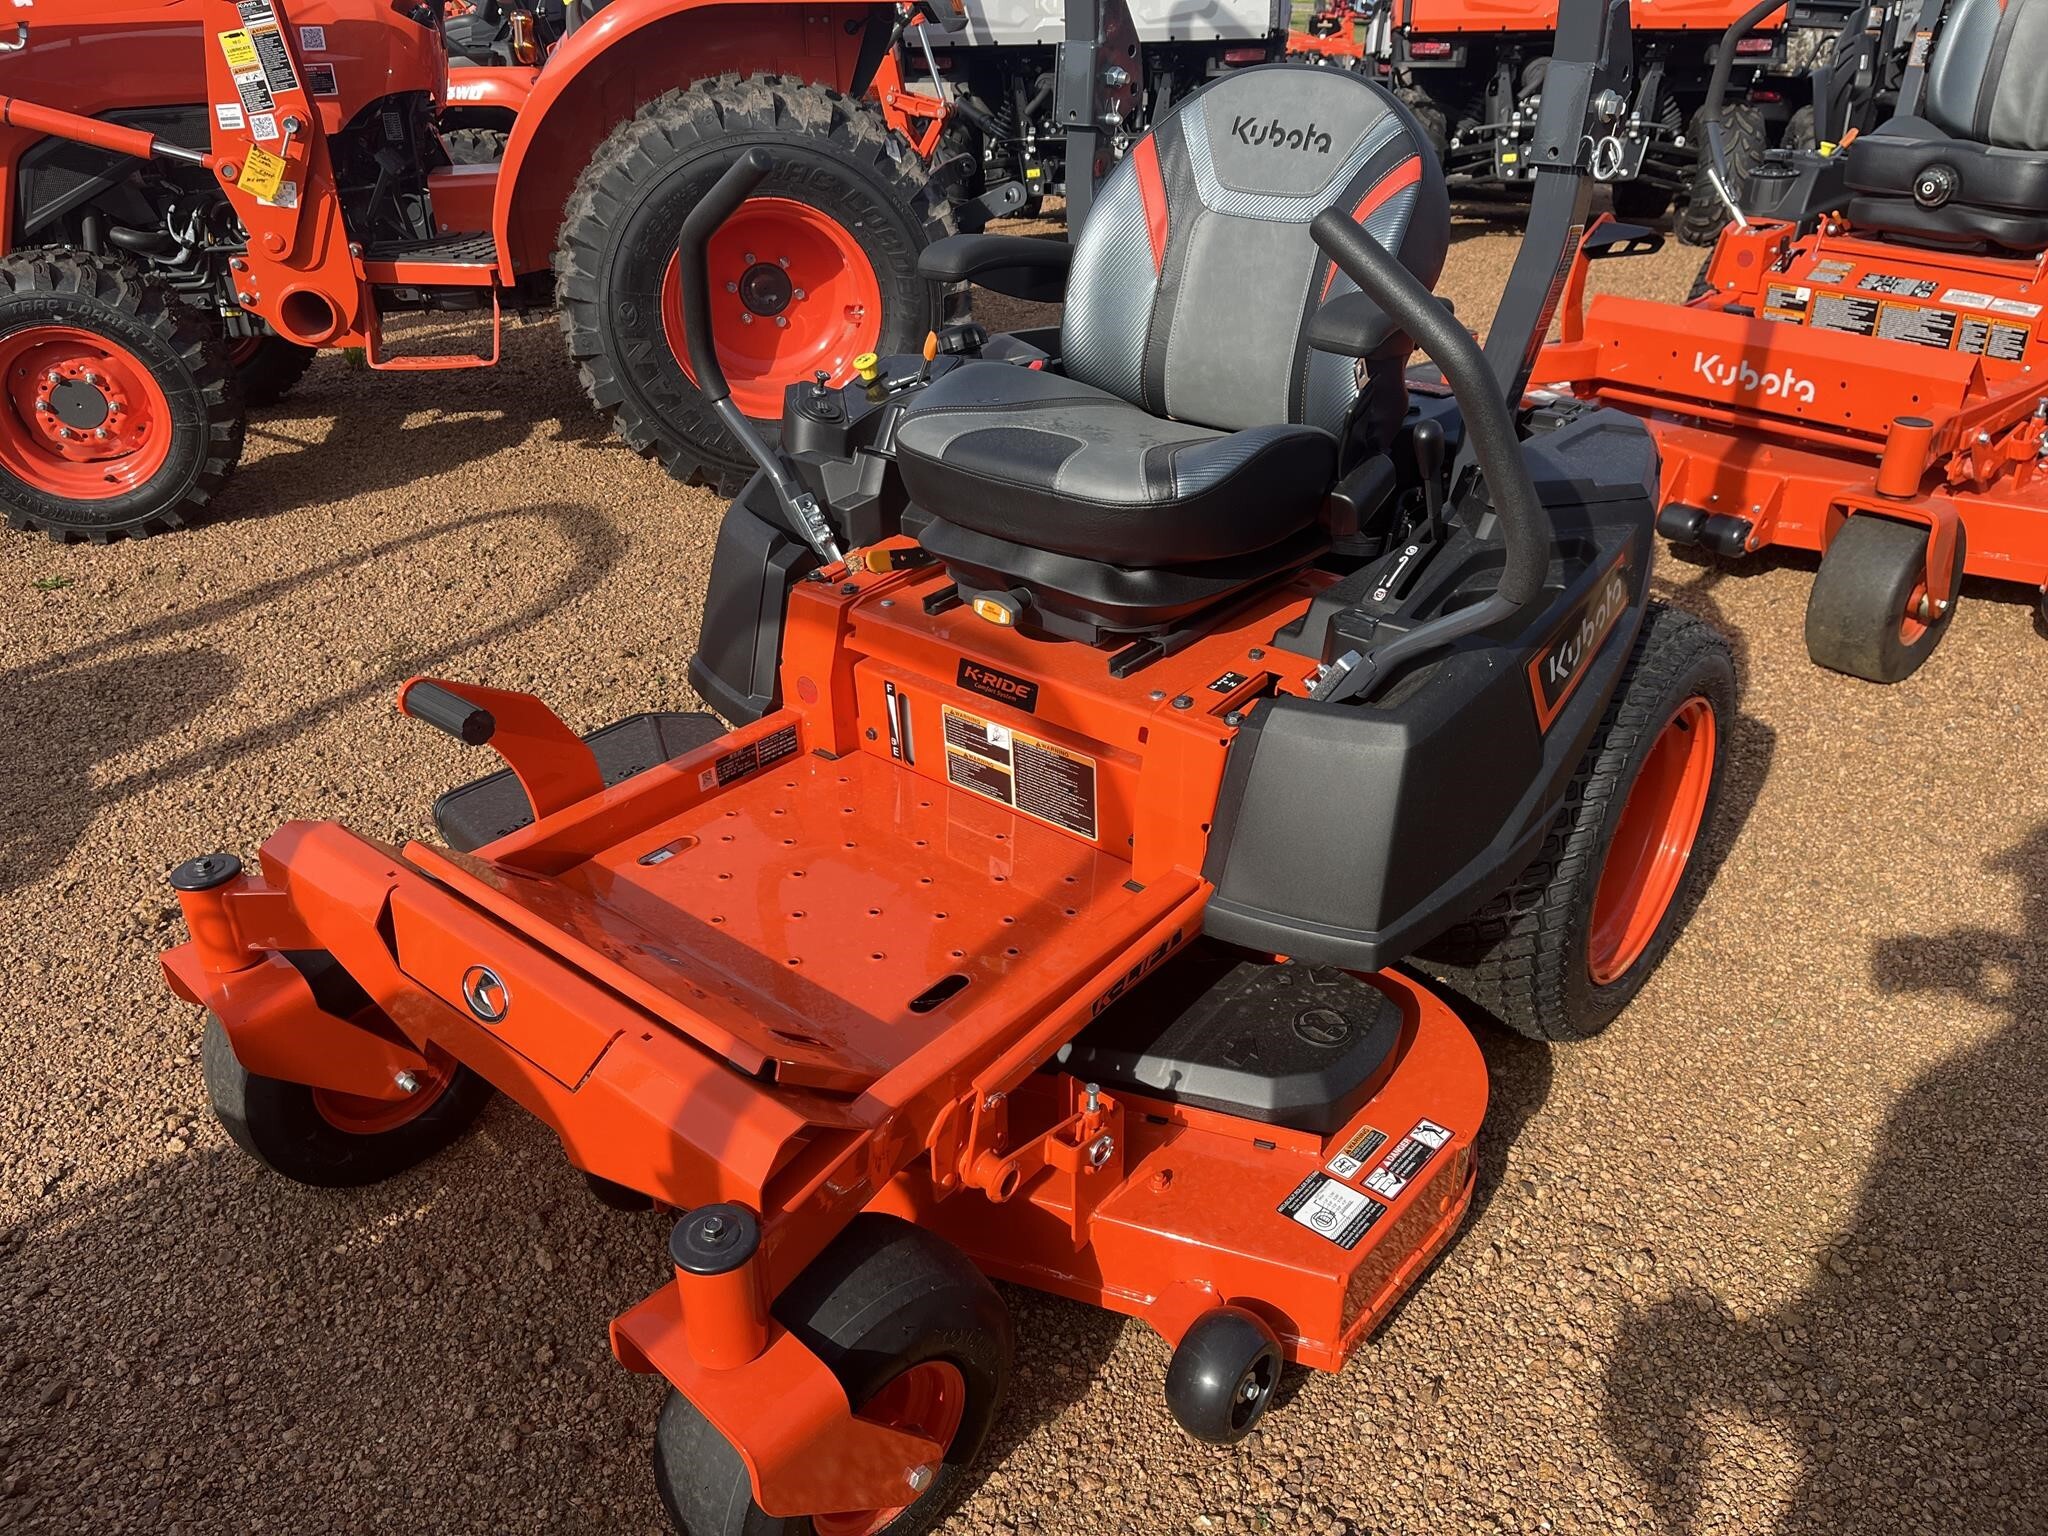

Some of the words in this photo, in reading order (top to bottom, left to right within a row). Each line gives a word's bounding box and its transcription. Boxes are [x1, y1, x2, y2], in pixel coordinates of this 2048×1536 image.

[1231, 116, 1332, 155] Kubota
[1693, 351, 1816, 403] Kubota
[1548, 576, 1624, 685] Kubota
[964, 665, 1033, 699] K-RIDE
[1387, 1138, 1412, 1162] DANGER
